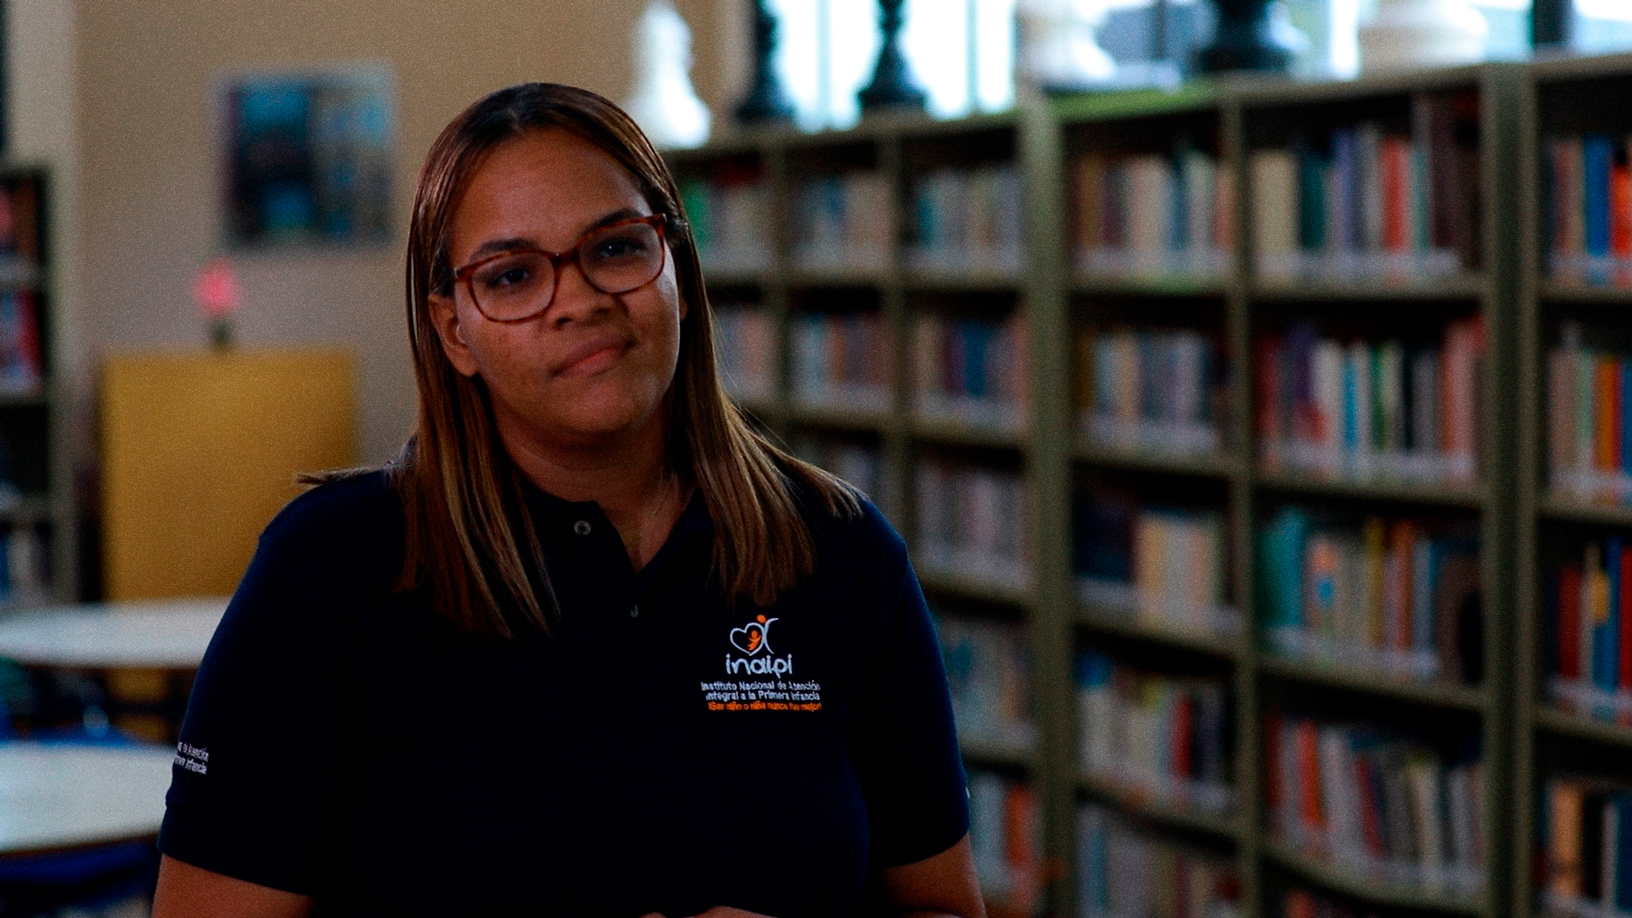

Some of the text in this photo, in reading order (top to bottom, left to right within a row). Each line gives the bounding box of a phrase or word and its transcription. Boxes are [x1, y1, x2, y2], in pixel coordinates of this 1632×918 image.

[725, 653, 793, 679] inaipi
[700, 681, 738, 691] Instituto
[739, 680, 775, 691] Nacional
[777, 680, 787, 690] de
[748, 691, 757, 700] la
[758, 690, 790, 701] Primera
